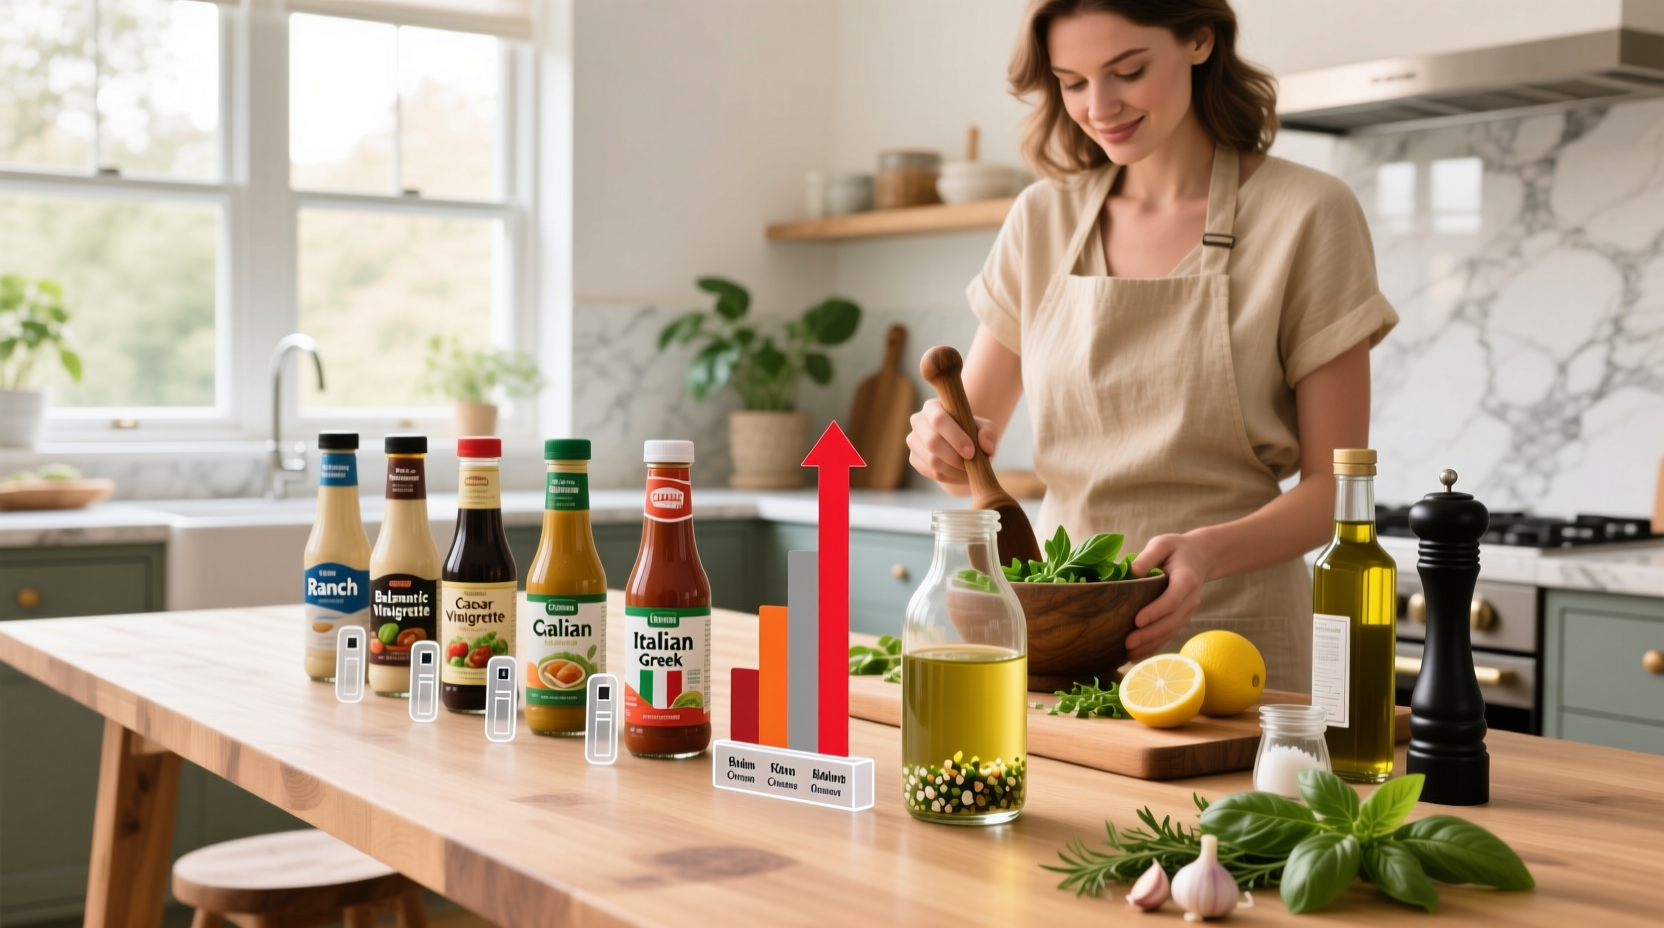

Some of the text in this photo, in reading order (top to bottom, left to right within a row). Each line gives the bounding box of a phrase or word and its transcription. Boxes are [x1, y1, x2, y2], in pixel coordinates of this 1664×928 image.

[308, 577, 358, 596] Ranch
[634, 631, 693, 650] Italian
[639, 652, 683, 667] Greek
